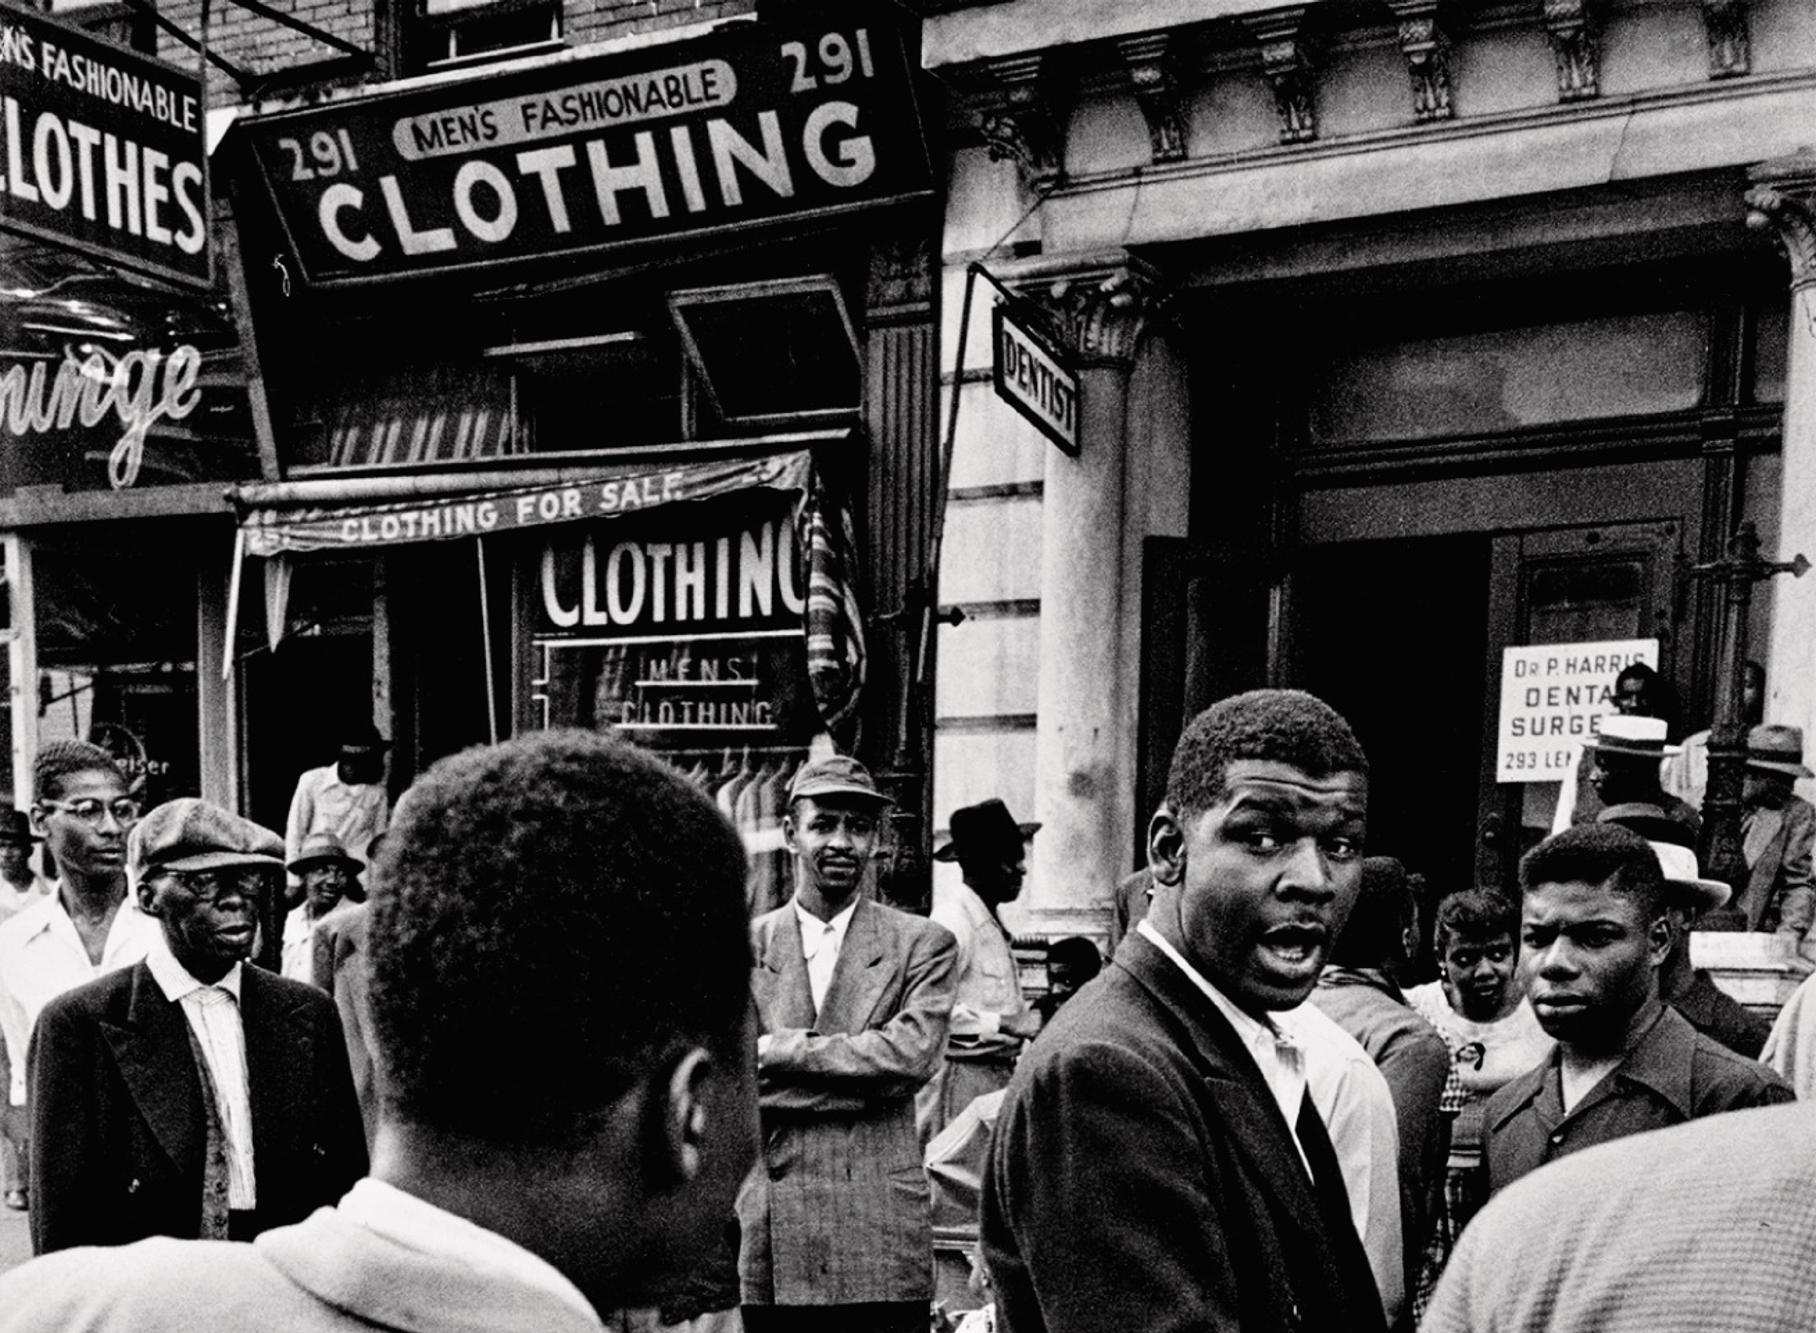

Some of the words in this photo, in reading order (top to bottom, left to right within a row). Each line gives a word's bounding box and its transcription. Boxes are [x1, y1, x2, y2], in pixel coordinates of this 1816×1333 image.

[0, 25, 35, 71] N'S
[41, 41, 198, 134] FASHIONABLE
[780, 28, 875, 95] 291
[410, 105, 499, 153] MEN'S
[520, 67, 722, 133] FASHIONABLE
[0, 96, 206, 255] LOTHES
[279, 128, 360, 182] 291
[318, 101, 877, 262] CLOTHING
[1003, 331, 1076, 432] DENTIST
[0, 344, 202, 489] unge
[341, 502, 499, 542] CLOTHING
[517, 489, 583, 524] FOR
[621, 700, 776, 727] CLOTHING
[1511, 713, 1603, 737] SURGE
[1525, 684, 1614, 708] DENTA
[1504, 750, 1537, 770] 293
[1545, 749, 1572, 769] LE
